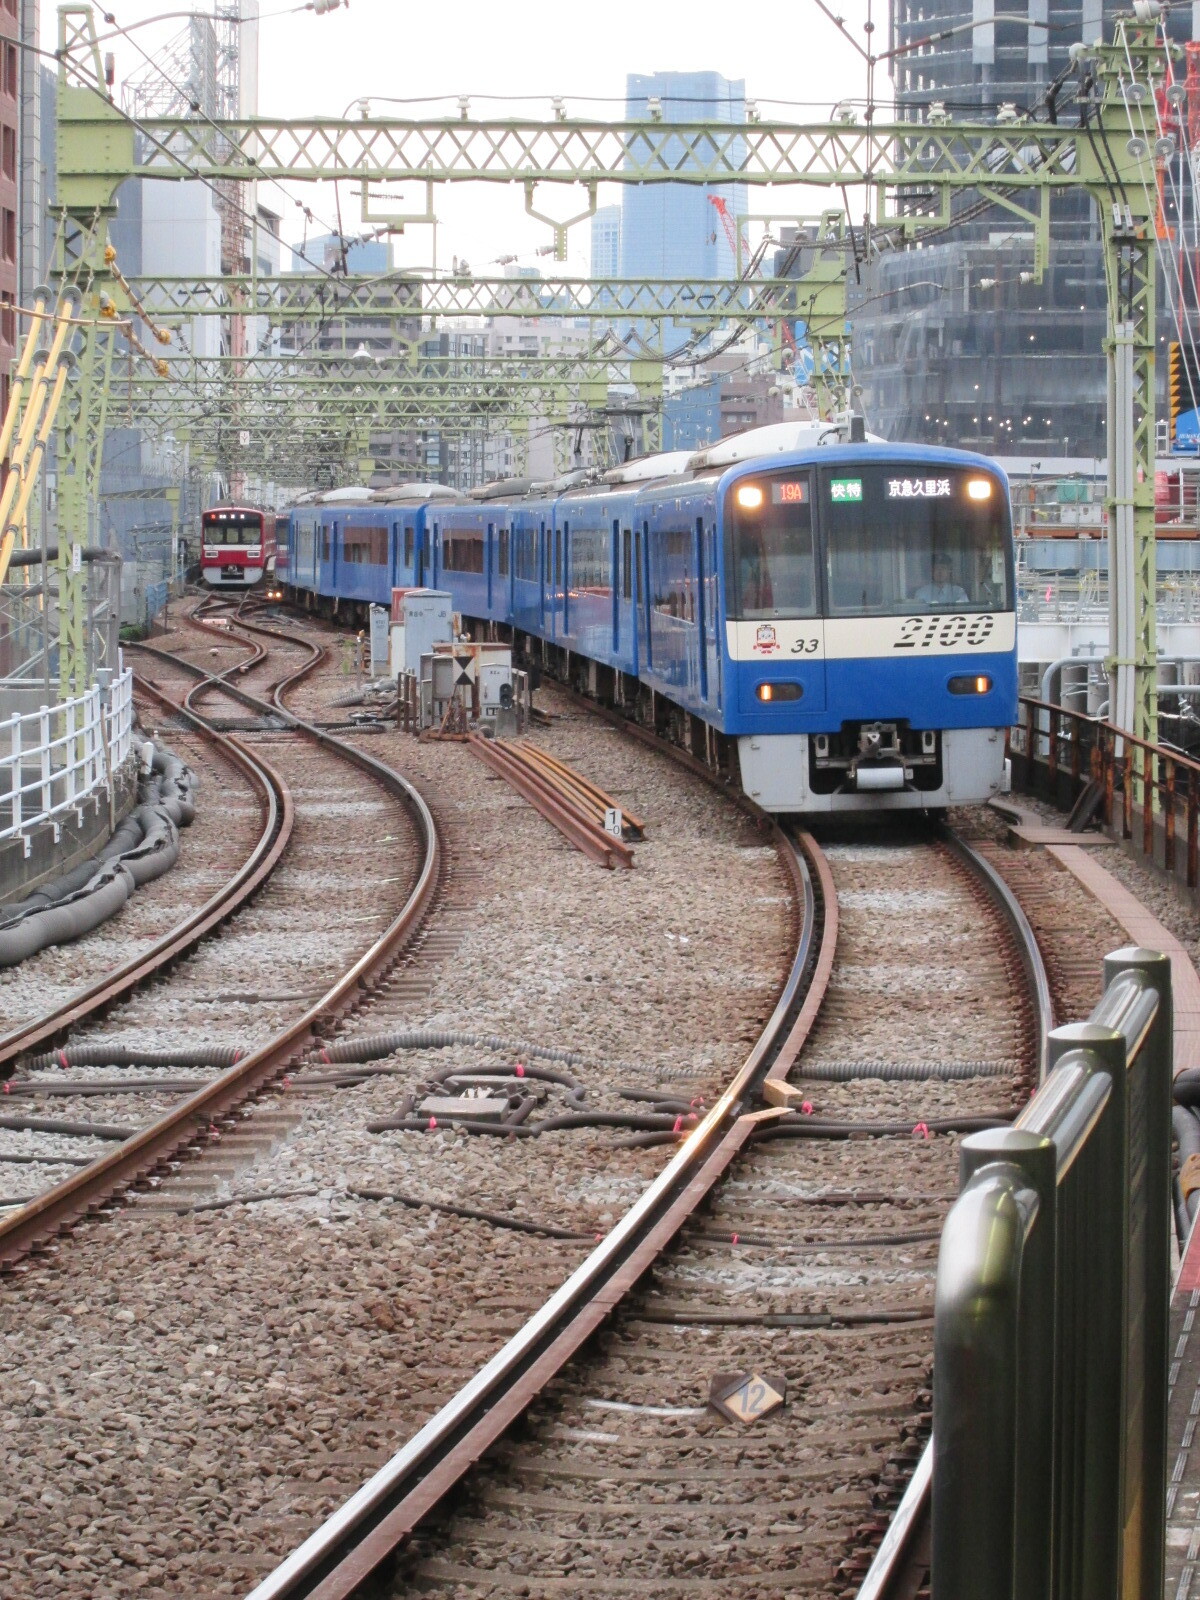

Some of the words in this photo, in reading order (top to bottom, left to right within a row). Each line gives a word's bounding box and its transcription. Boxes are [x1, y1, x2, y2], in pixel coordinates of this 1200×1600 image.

[780, 483, 802, 500] 19A
[831, 480, 861, 499] 快特
[888, 479, 951, 497] 京急久里浜
[893, 615, 994, 648] 2100
[790, 639, 819, 654] 33
[609, 811, 615, 824] 1
[737, 1384, 766, 1413] 12
